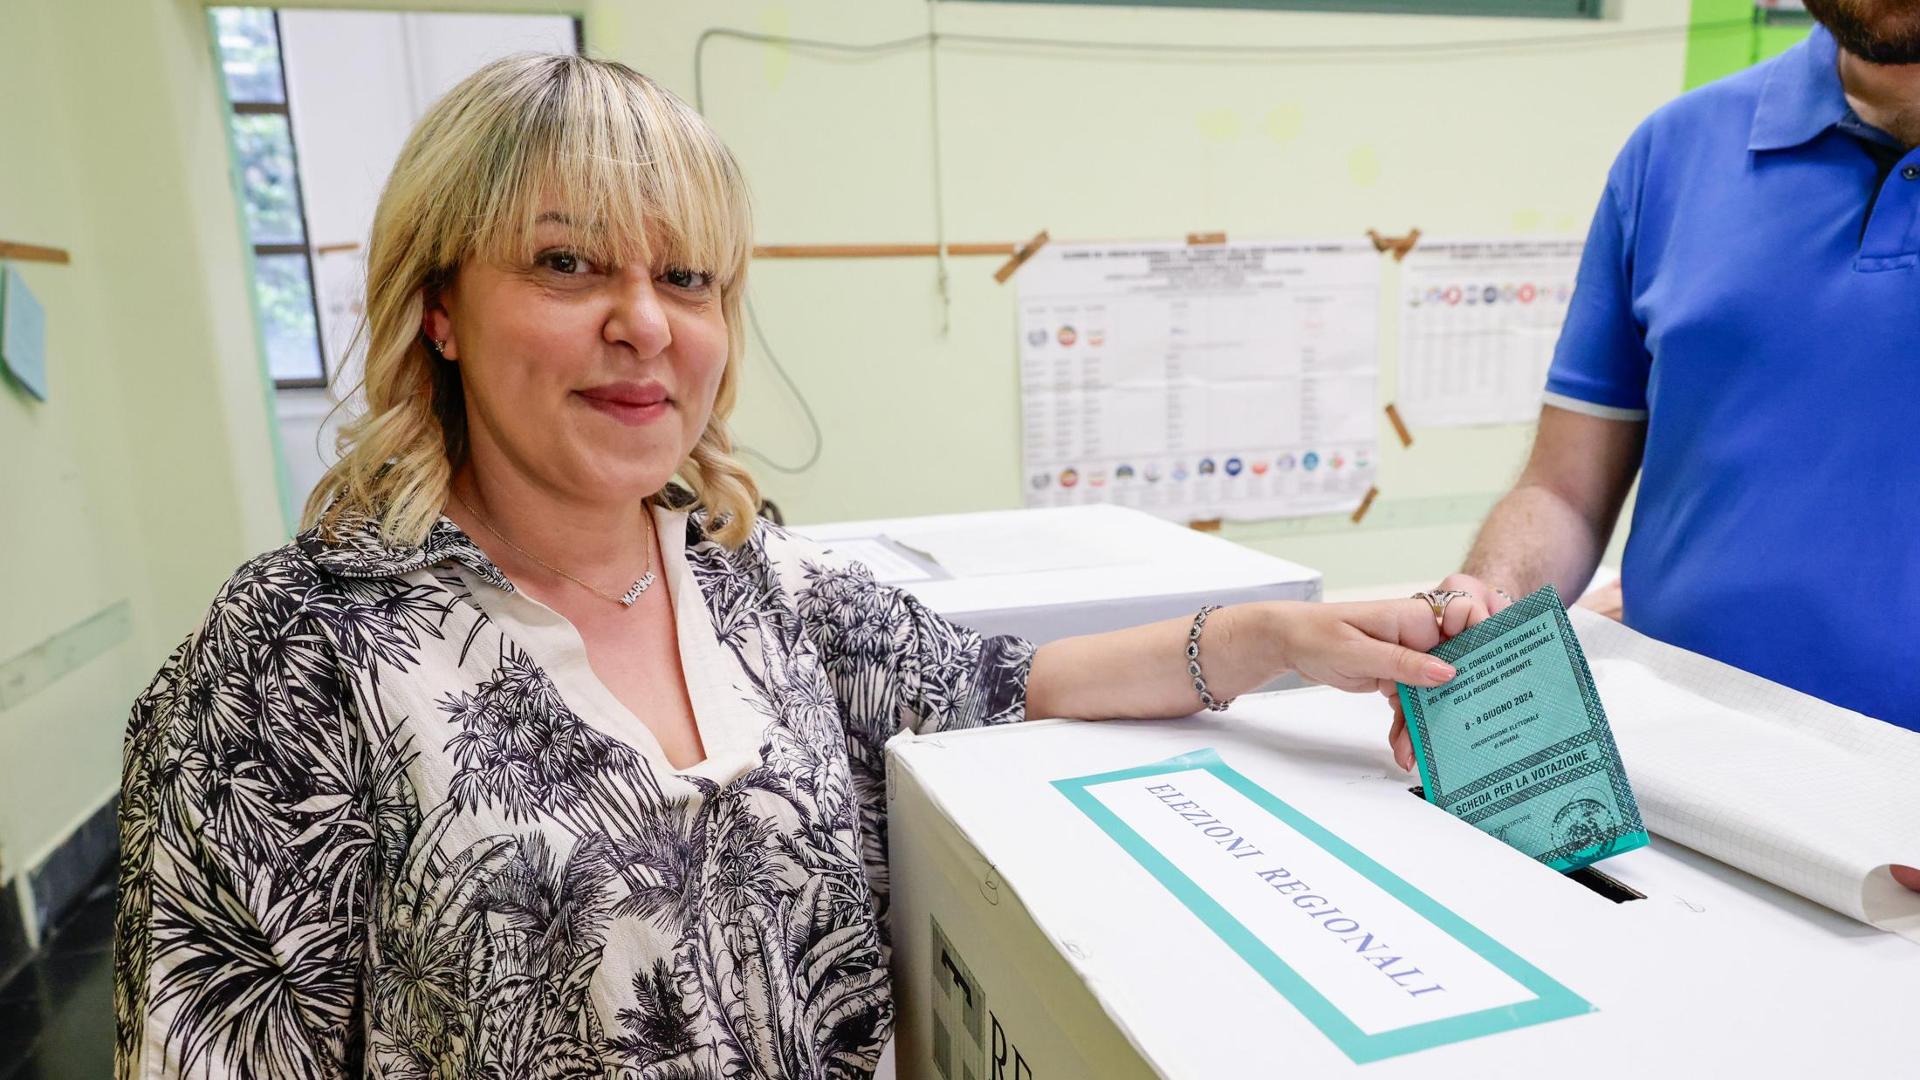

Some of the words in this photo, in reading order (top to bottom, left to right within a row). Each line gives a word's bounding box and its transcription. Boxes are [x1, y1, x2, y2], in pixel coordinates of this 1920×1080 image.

[1427, 695, 1440, 706] DEL
[1440, 676, 1475, 700] PRESIDENTE
[1476, 665, 1496, 680] DELLA
[1496, 654, 1519, 670] GIUNTA
[1520, 632, 1556, 656] REGIONALE
[1455, 667, 1468, 677] DEL
[1468, 648, 1503, 670] CONSIGLIO
[1504, 626, 1543, 650] REGIONALE
[1543, 622, 1548, 630] E
[1453, 692, 1472, 705] DELLA
[1473, 676, 1500, 695] REGIONE
[1500, 659, 1533, 681] PIEMONTE
[1464, 722, 1471, 731] 8
[1476, 716, 1482, 725] 9
[1483, 701, 1513, 722] GIUGNO
[1513, 690, 1534, 706] 2024
[1509, 713, 1540, 731] ELETTORALE
[1455, 792, 1492, 816] SCHEDA
[1494, 781, 1513, 800] PER
[1515, 775, 1529, 789] LA
[1530, 749, 1590, 781] VOTAZIONE
[1144, 782, 1264, 859] ELEZIONI
[1255, 866, 1446, 998] REGIONALI
